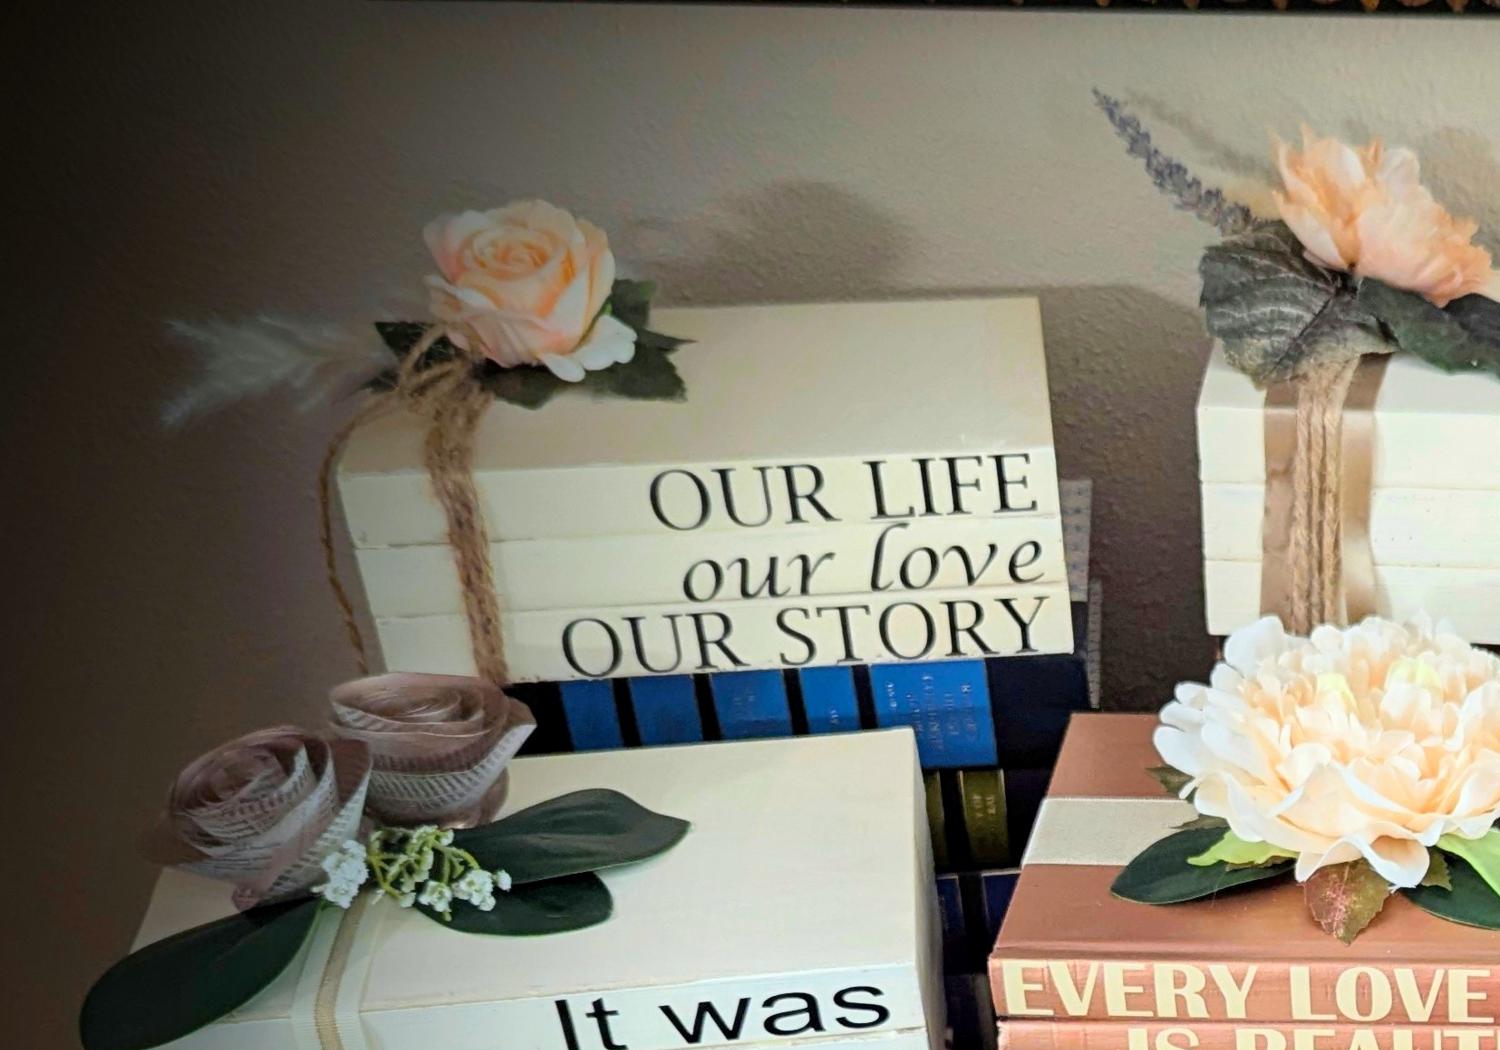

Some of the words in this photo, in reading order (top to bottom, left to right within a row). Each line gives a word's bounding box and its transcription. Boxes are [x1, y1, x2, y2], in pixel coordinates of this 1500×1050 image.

[649, 464, 842, 531] OUR
[863, 453, 1038, 519] LIFE
[682, 549, 836, 601] our
[870, 522, 1046, 593] love
[561, 611, 752, 678] OUR
[775, 596, 1052, 667] STORY
[659, 985, 891, 1044] was
[1002, 958, 1257, 1019] EVERY
[1290, 964, 1496, 1023] LOVE
